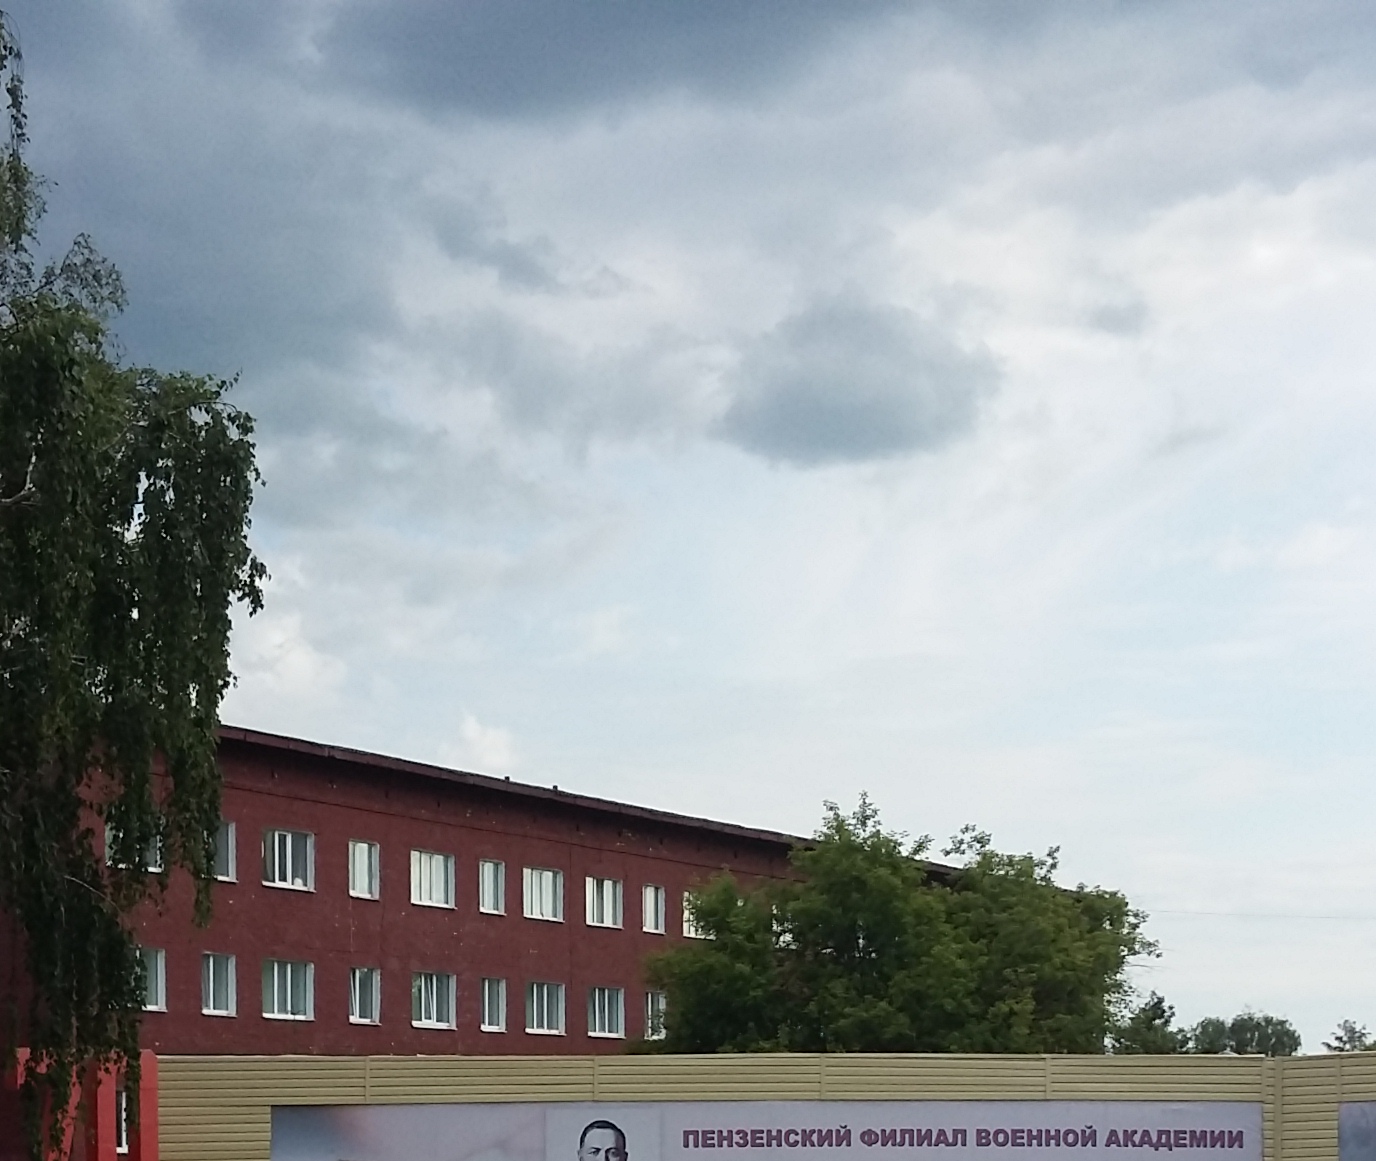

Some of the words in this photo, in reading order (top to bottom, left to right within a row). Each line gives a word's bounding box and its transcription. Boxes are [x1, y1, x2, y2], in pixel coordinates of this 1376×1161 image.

[682, 1124, 852, 1149] ПЕНЗЕНСКИЙ
[859, 1128, 968, 1148] ФИЛИАЛ
[975, 1124, 1098, 1148] ВОЕННОЙ
[1104, 1128, 1244, 1152] АКАДЕМИИ
